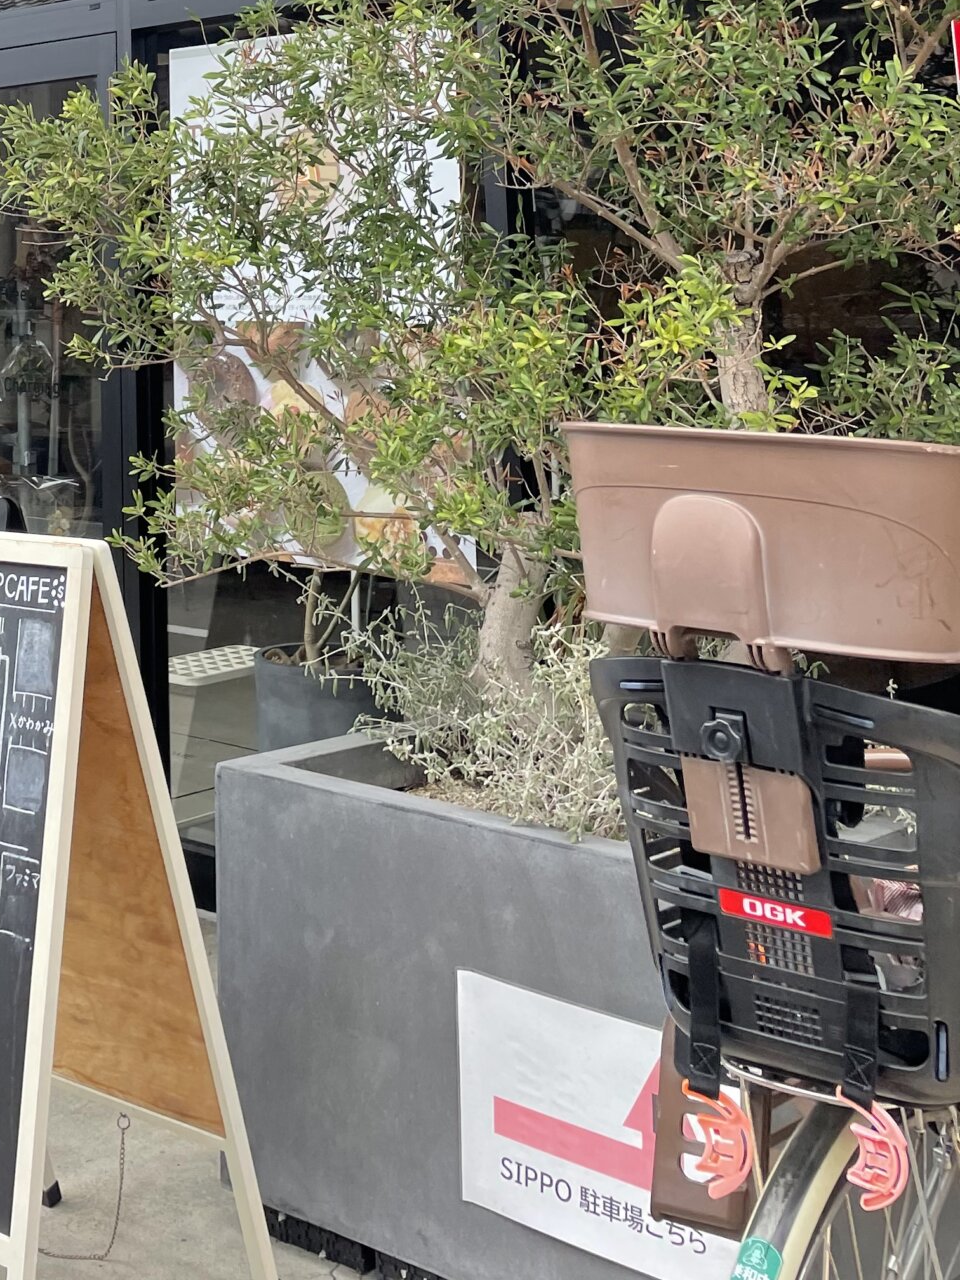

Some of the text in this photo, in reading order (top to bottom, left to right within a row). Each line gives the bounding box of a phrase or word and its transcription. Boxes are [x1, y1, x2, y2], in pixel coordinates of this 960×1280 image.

[4, 575, 51, 604] CAFE
[742, 897, 807, 928] OGK
[499, 1156, 573, 1203] SIPPO
